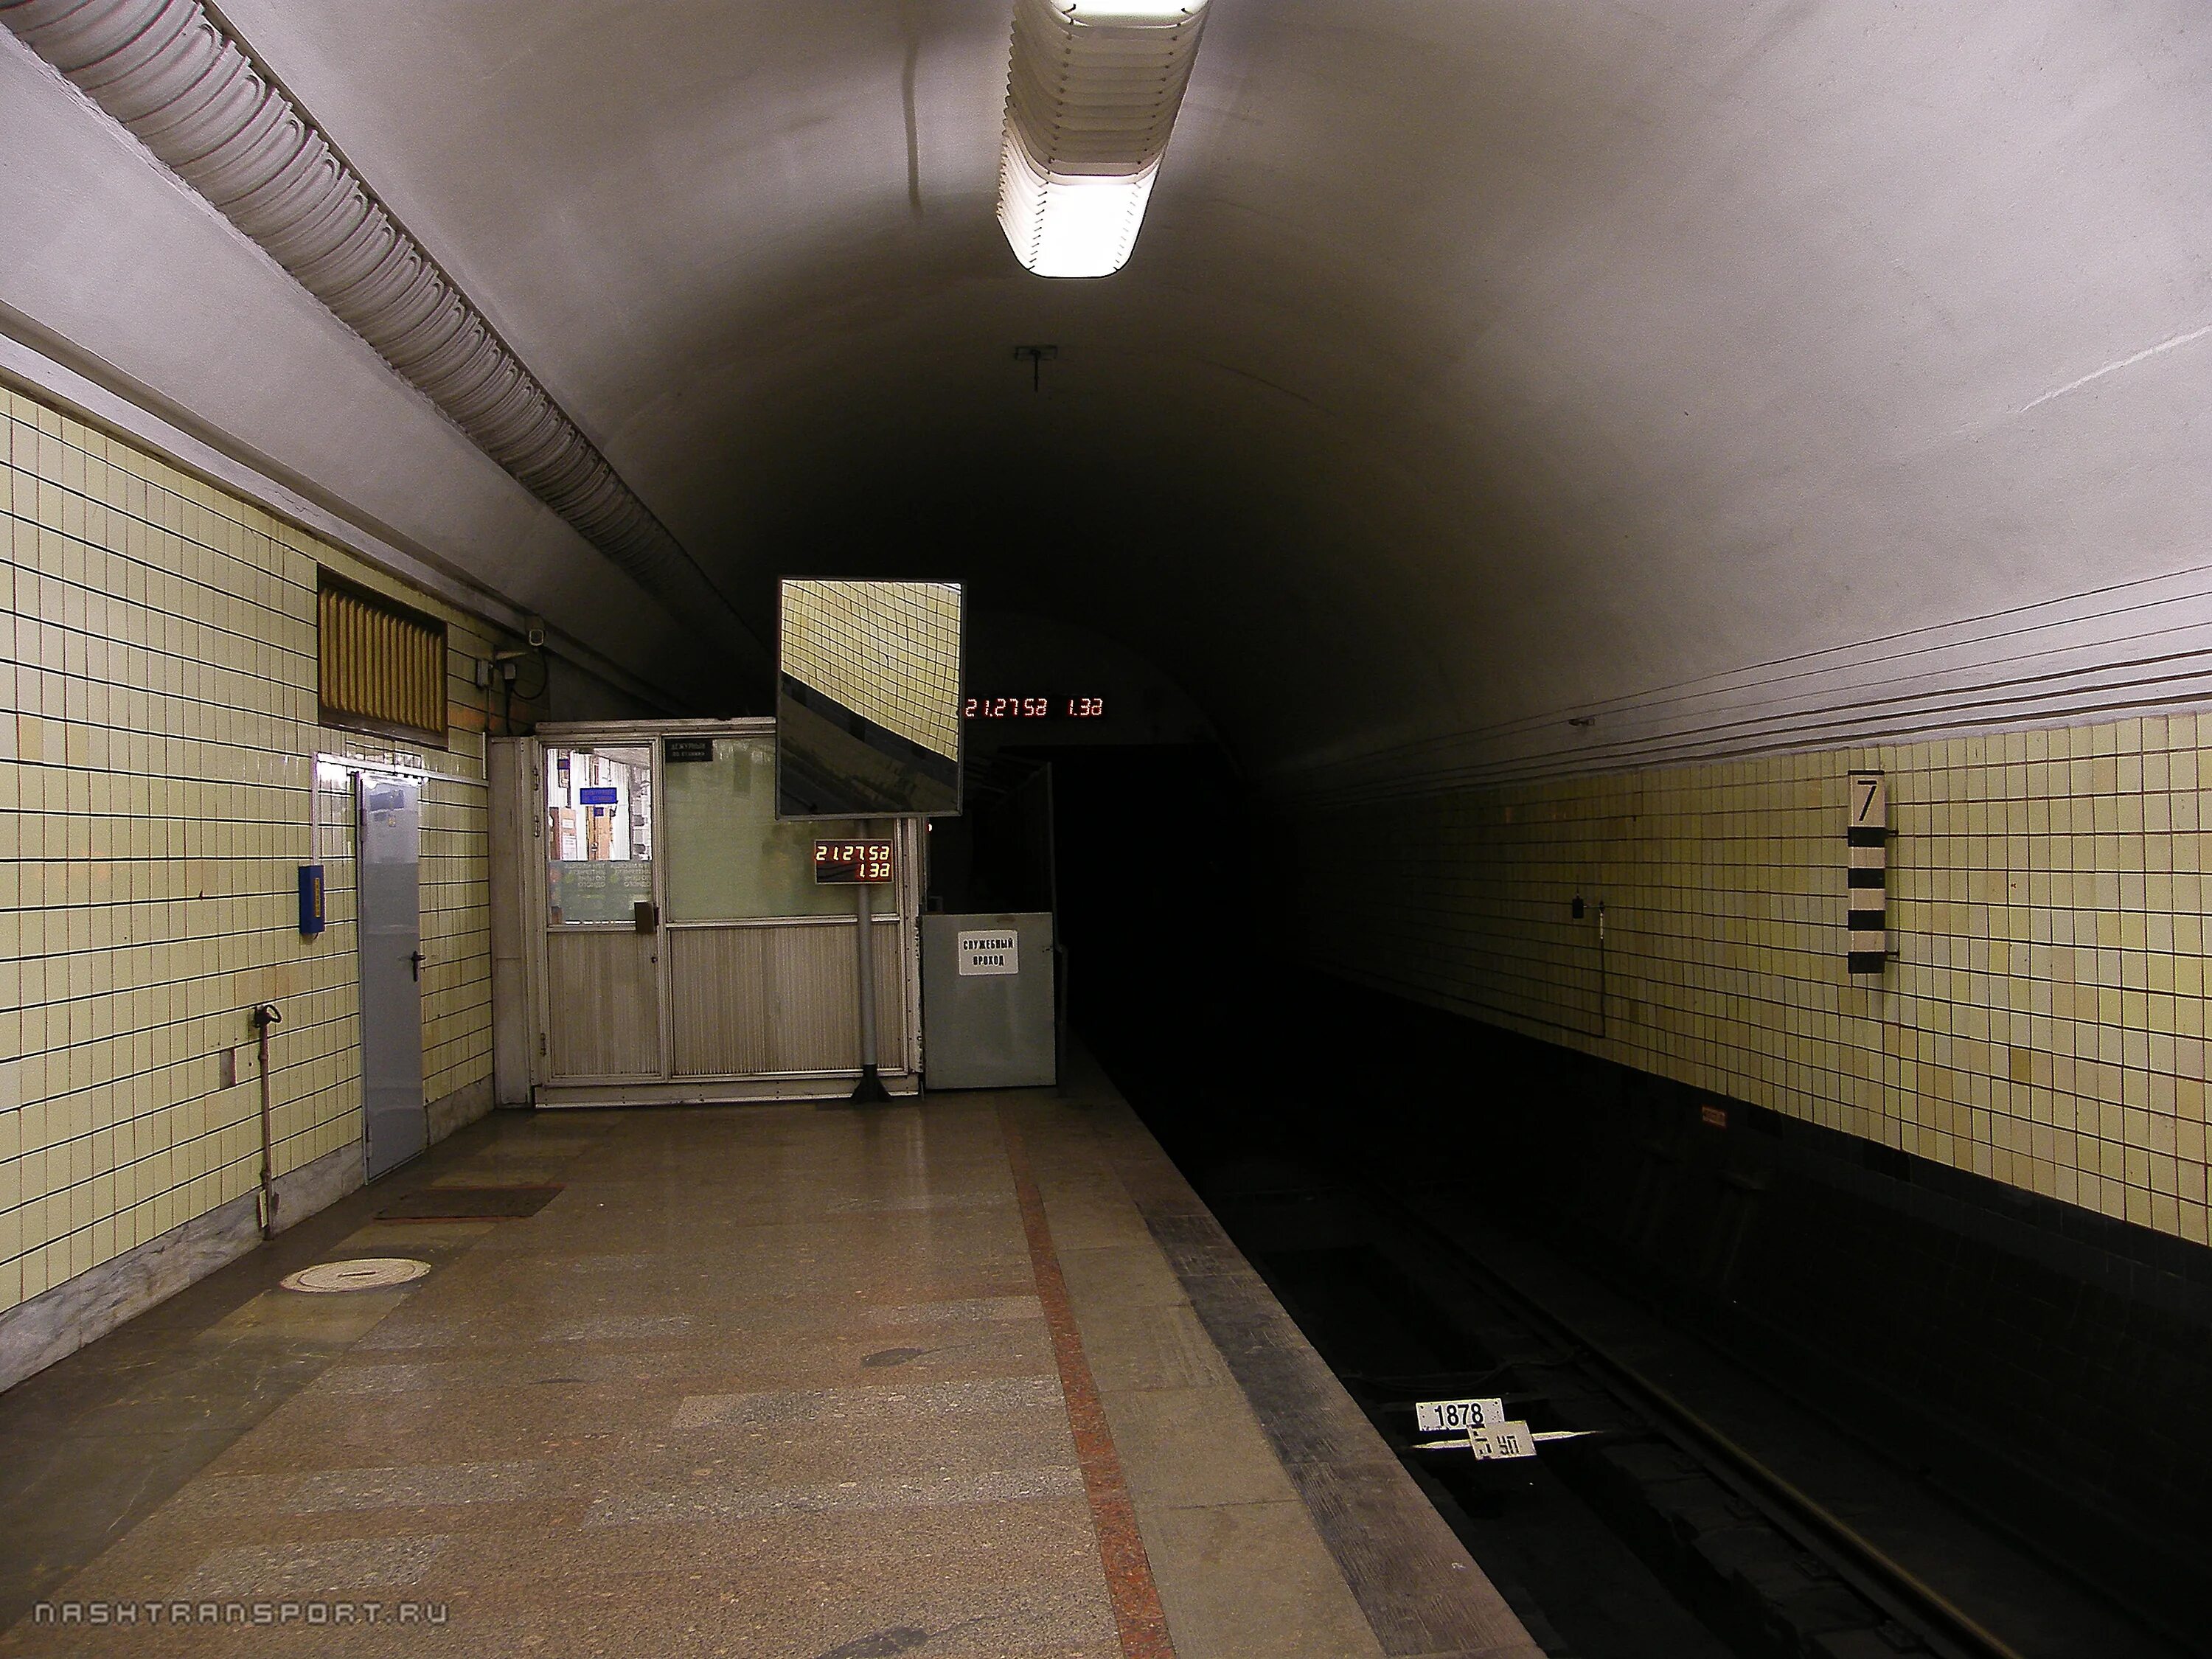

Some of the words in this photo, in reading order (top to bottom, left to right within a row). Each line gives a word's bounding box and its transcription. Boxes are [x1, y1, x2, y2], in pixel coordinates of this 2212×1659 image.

[1857, 780, 1878, 822] 7
[963, 937, 1014, 951] СЛУЖЕБНЫЙ
[1433, 1402, 1484, 1427] 1878
